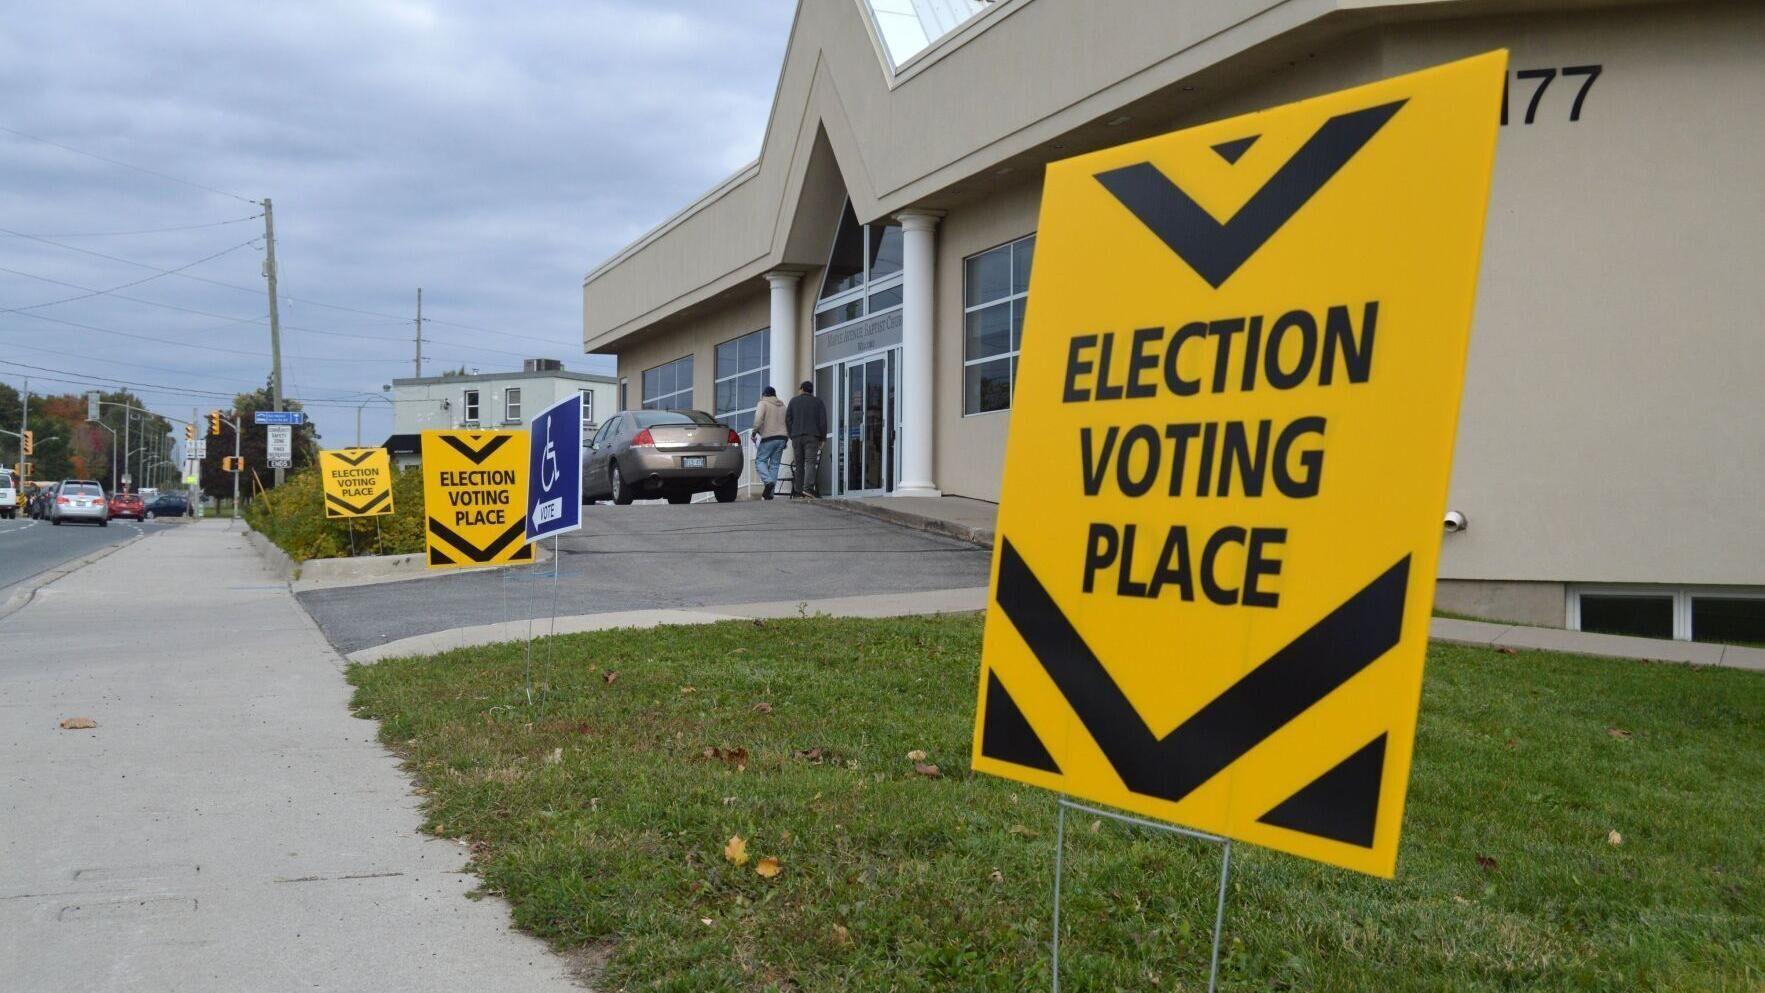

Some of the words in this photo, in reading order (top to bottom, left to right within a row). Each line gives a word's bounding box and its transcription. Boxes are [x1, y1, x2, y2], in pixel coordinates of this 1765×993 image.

[864, 320, 885, 336] BAPTIST
[1062, 301, 1379, 404] ELECTION
[1080, 416, 1327, 499] VOTING
[331, 467, 379, 478] ELECTION
[440, 470, 516, 487] ELECTION
[337, 477, 376, 488] VOTING
[342, 487, 374, 497] PLACE
[448, 489, 510, 507] VOTING
[455, 509, 506, 526] PLACE
[540, 503, 555, 521] VOTE
[1082, 522, 1288, 609] PLACE
